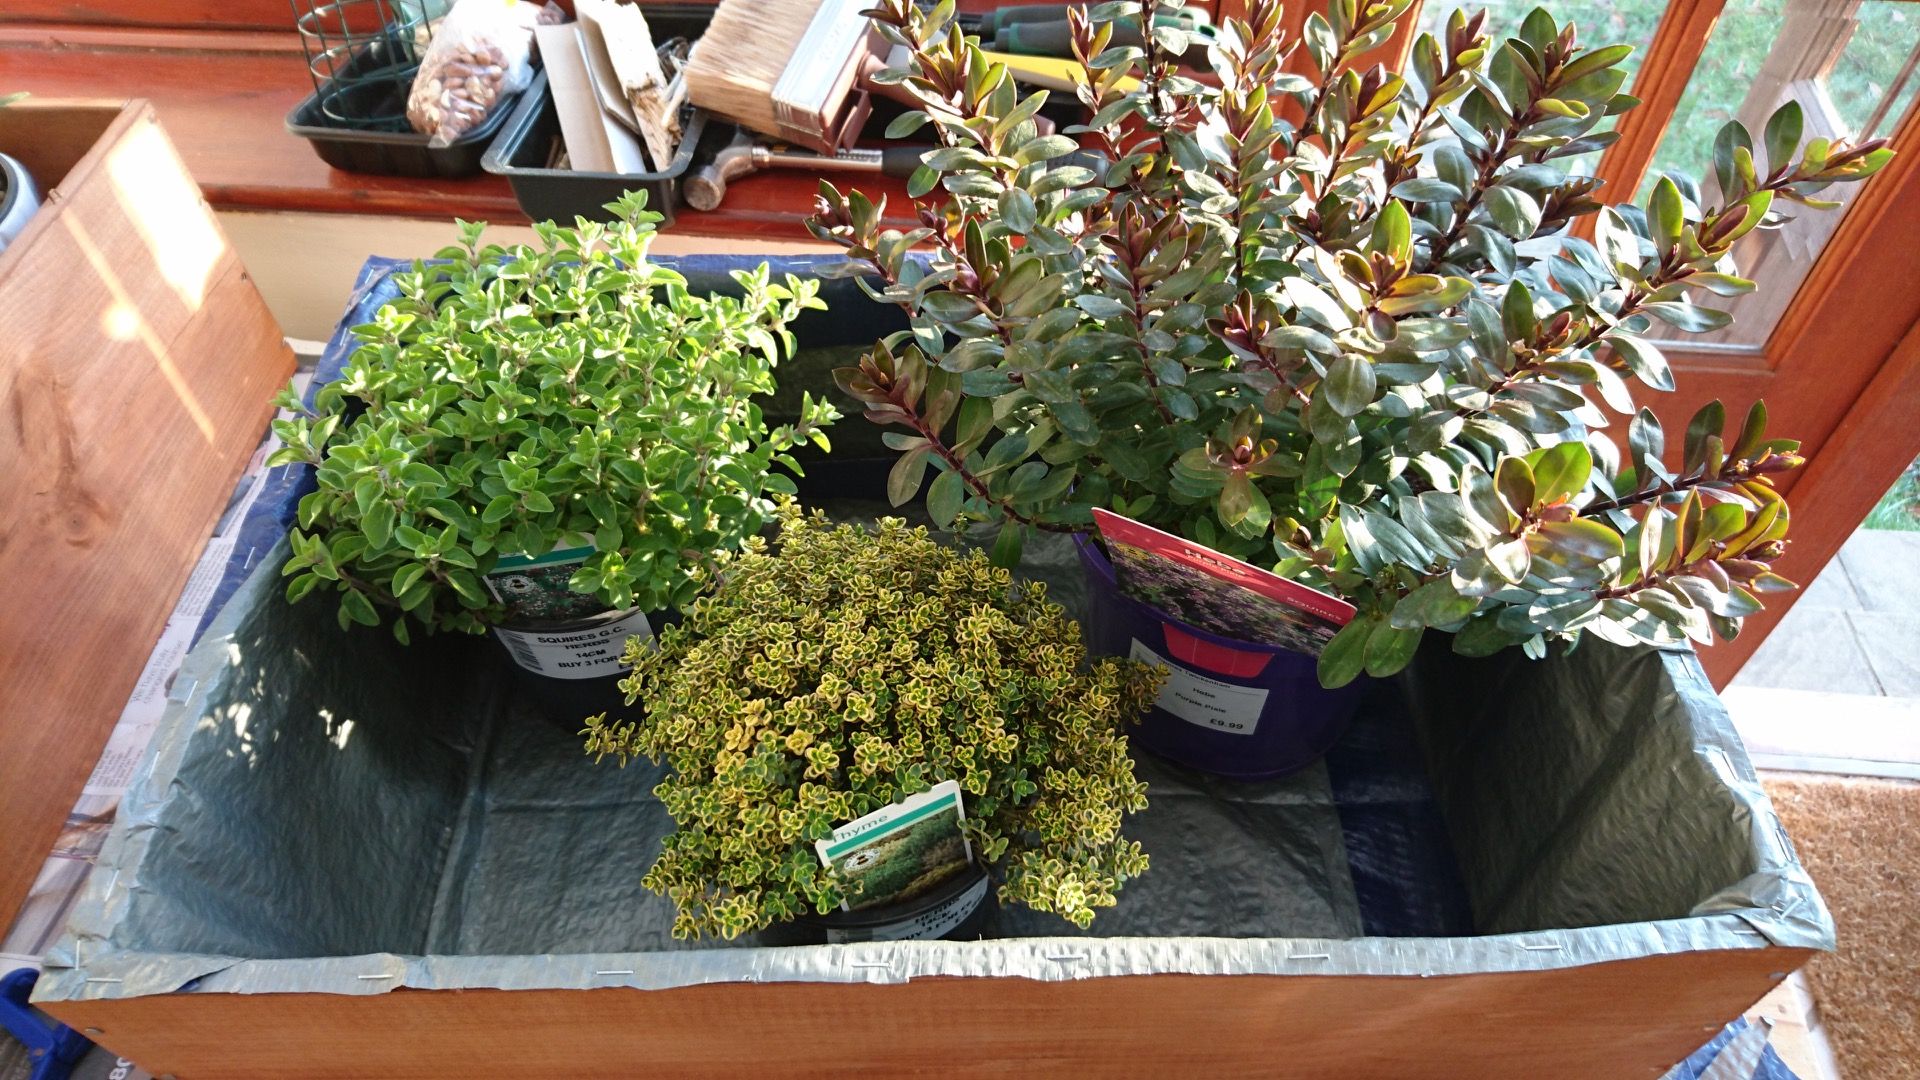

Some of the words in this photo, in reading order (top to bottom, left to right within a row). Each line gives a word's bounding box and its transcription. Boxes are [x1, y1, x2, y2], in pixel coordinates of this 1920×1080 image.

[1184, 548, 1245, 574] Hebe
[538, 633, 596, 644] SQUIRES
[599, 626, 626, 637] G.C.
[565, 639, 610, 650] HERBS
[576, 649, 607, 659] 14CM
[558, 661, 582, 669] BUY
[594, 656, 619, 665] FOR
[1209, 718, 1245, 730] £9.99
